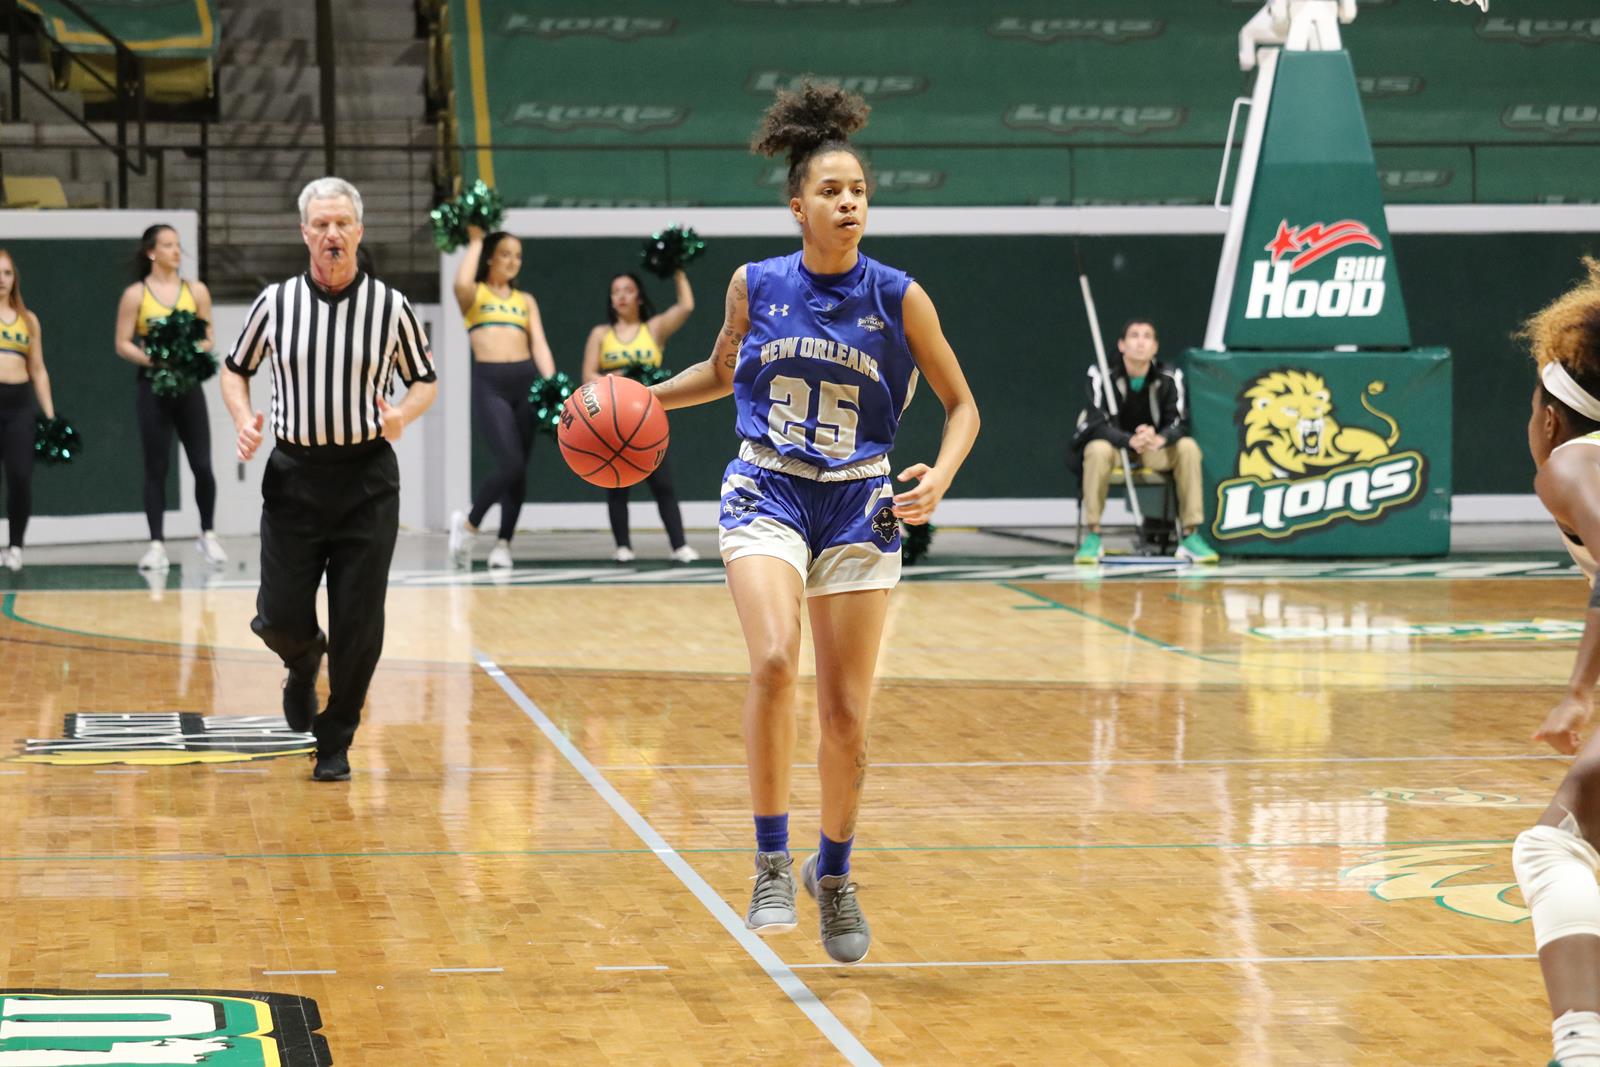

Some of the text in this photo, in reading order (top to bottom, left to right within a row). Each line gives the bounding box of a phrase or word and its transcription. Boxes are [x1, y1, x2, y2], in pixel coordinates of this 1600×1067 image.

[760, 336, 881, 383] NEW ORLEANS
[768, 374, 861, 461] 25
